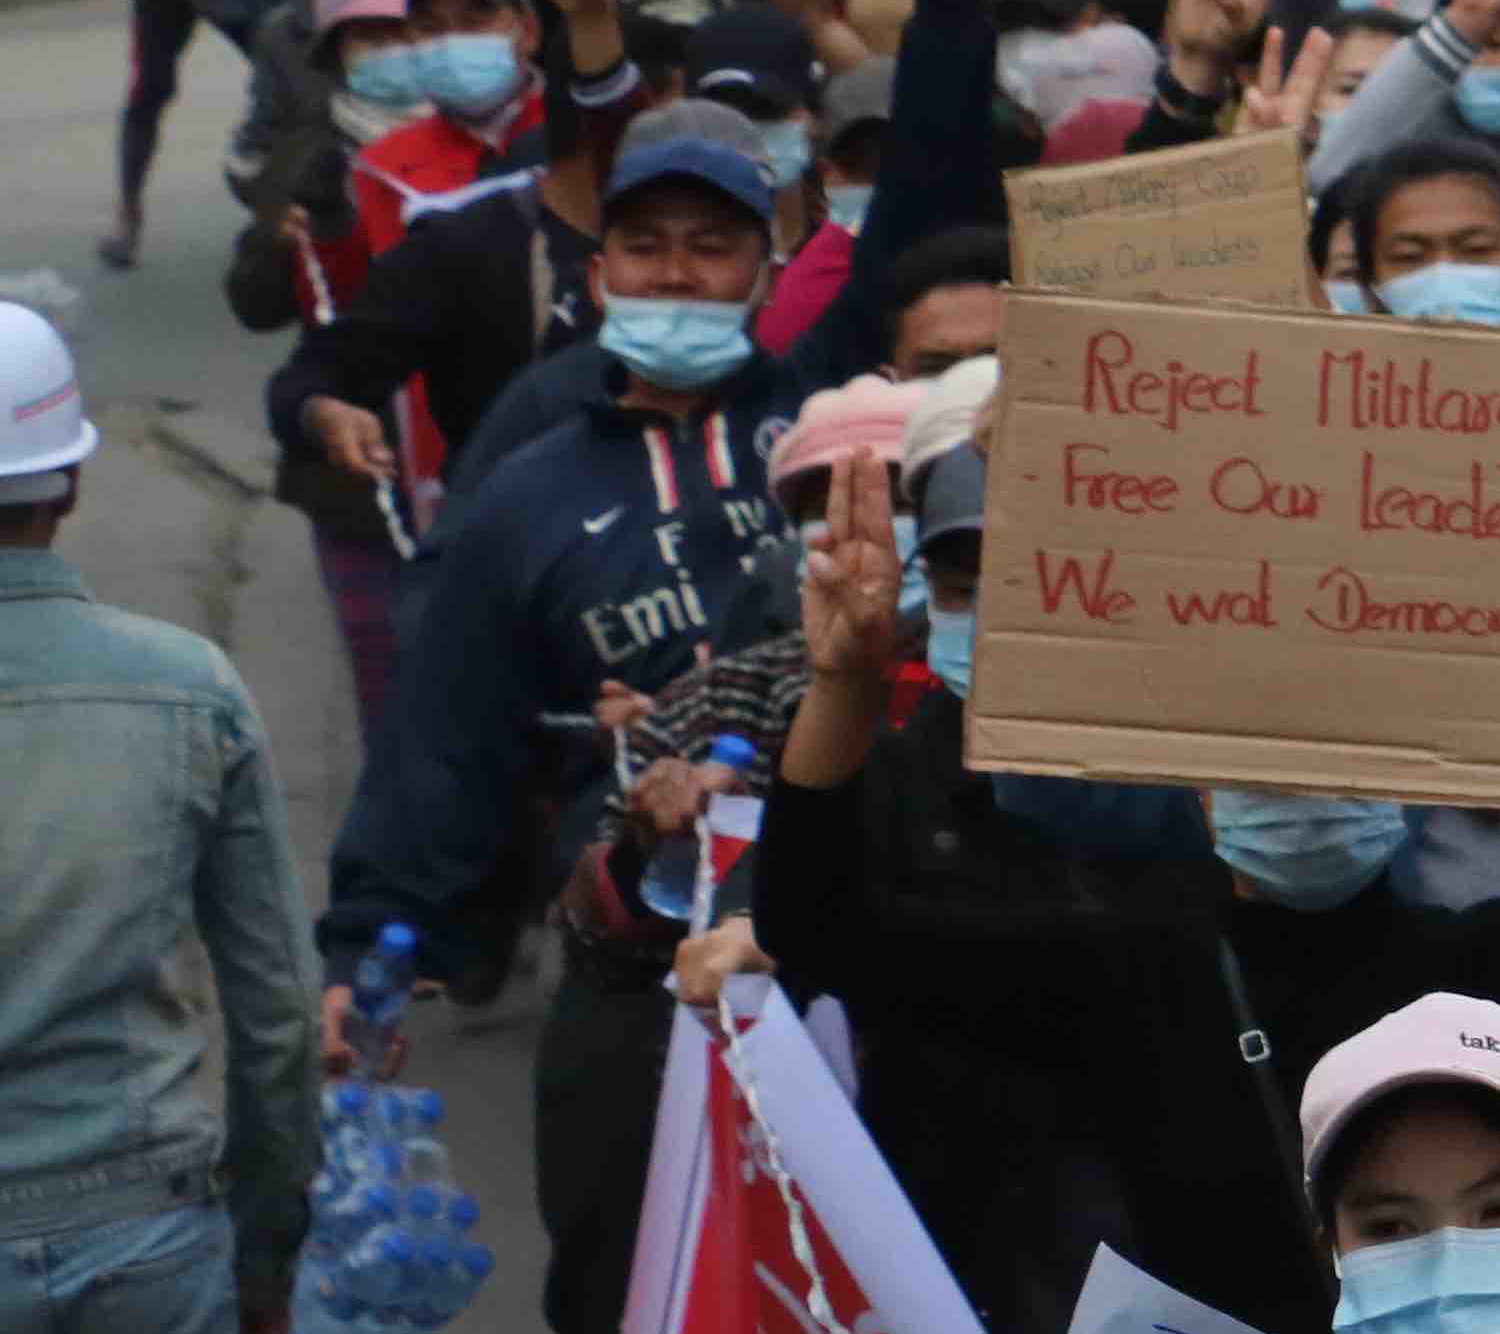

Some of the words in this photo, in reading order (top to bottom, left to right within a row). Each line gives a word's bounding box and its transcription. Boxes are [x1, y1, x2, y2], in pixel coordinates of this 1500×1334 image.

[1081, 328, 1265, 432] Reject
[1062, 441, 1181, 516] Free
[1209, 455, 1326, 519] Our
[1033, 546, 1138, 625] We
